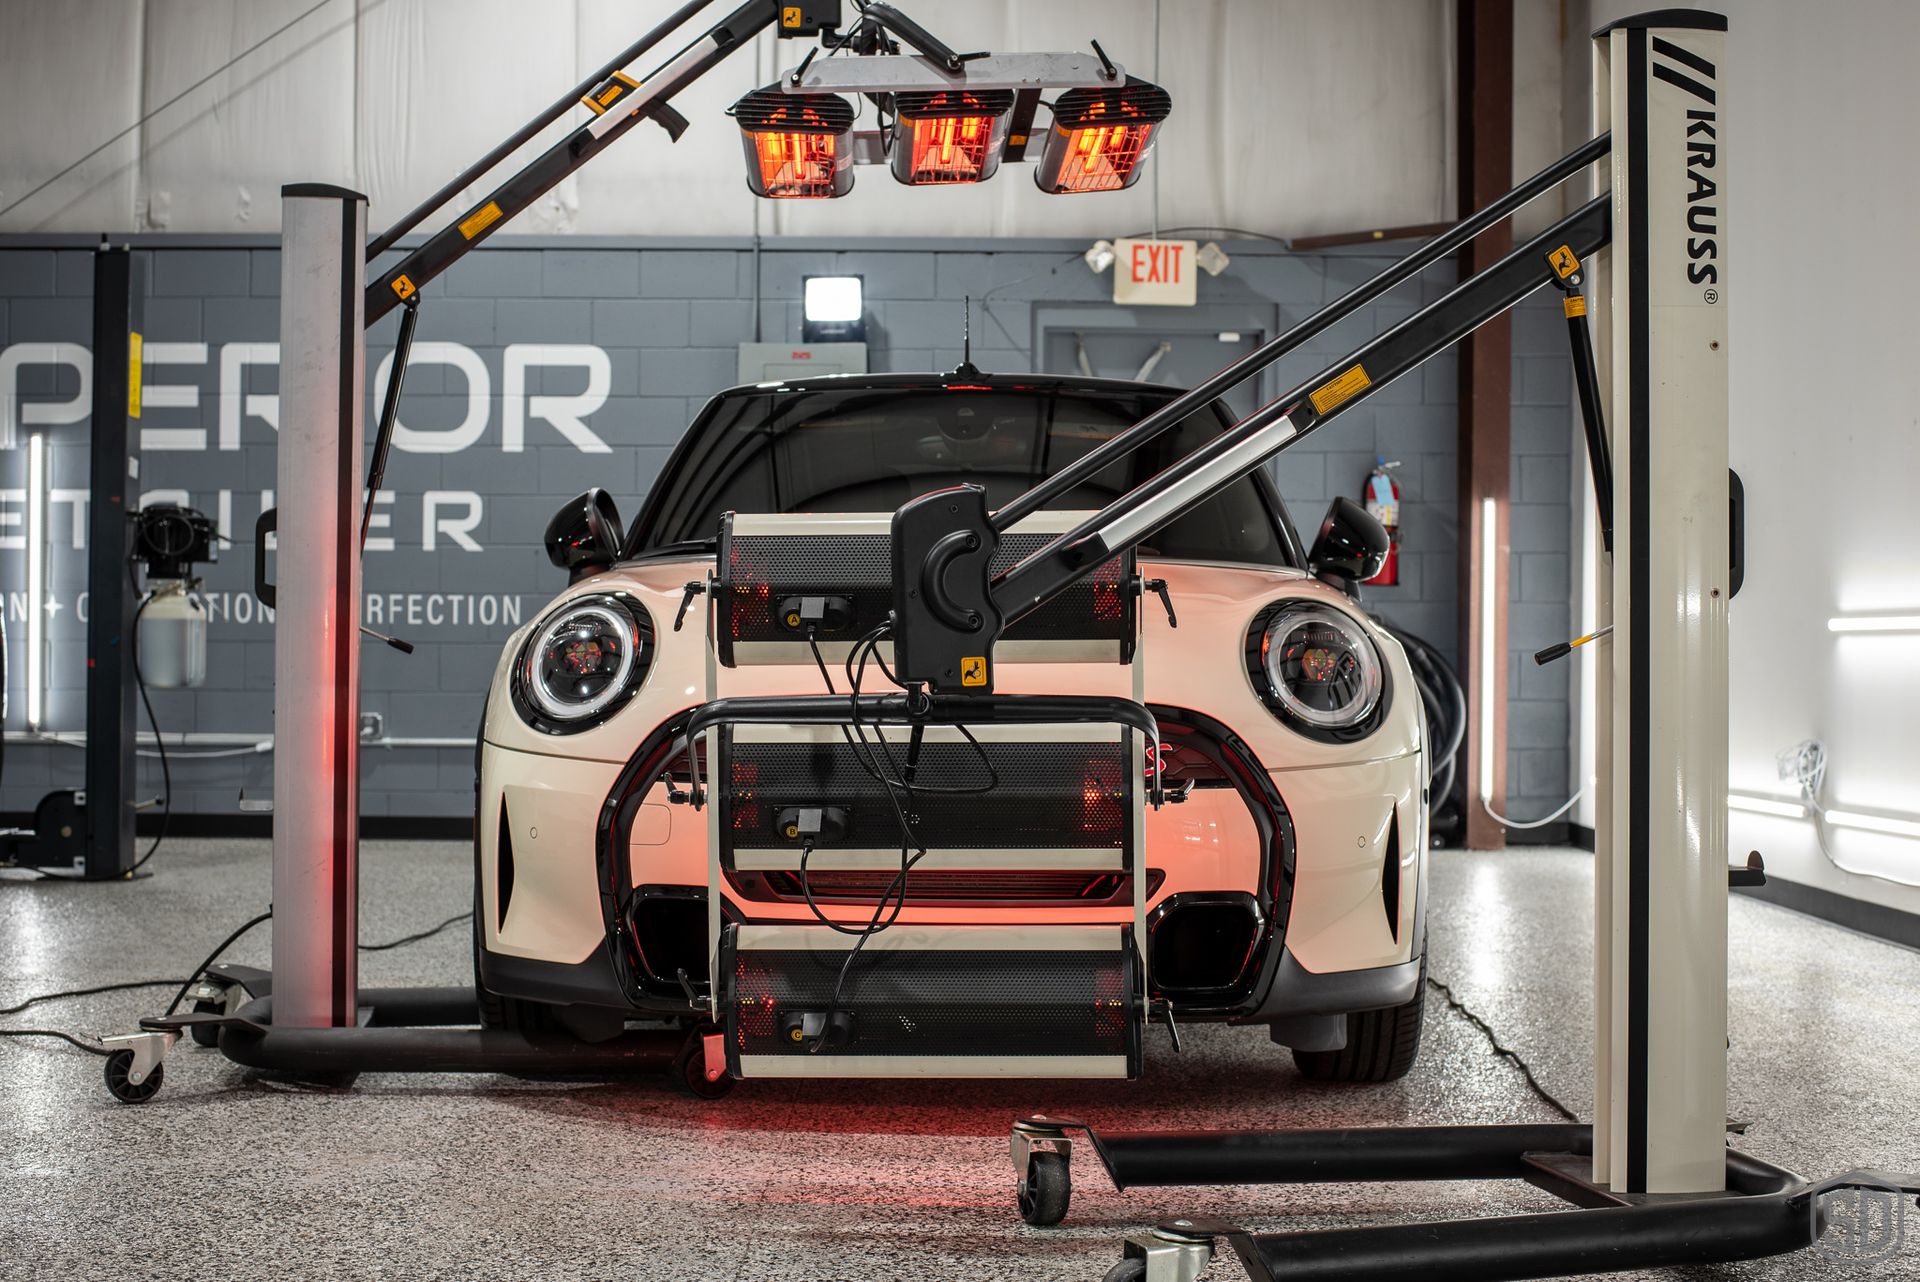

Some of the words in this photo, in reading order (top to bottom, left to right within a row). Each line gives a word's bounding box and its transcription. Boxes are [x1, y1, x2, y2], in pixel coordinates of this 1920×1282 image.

[1131, 244, 1184, 284] EXIT
[0, 342, 613, 453] PEROR
[790, 614, 799, 624] A
